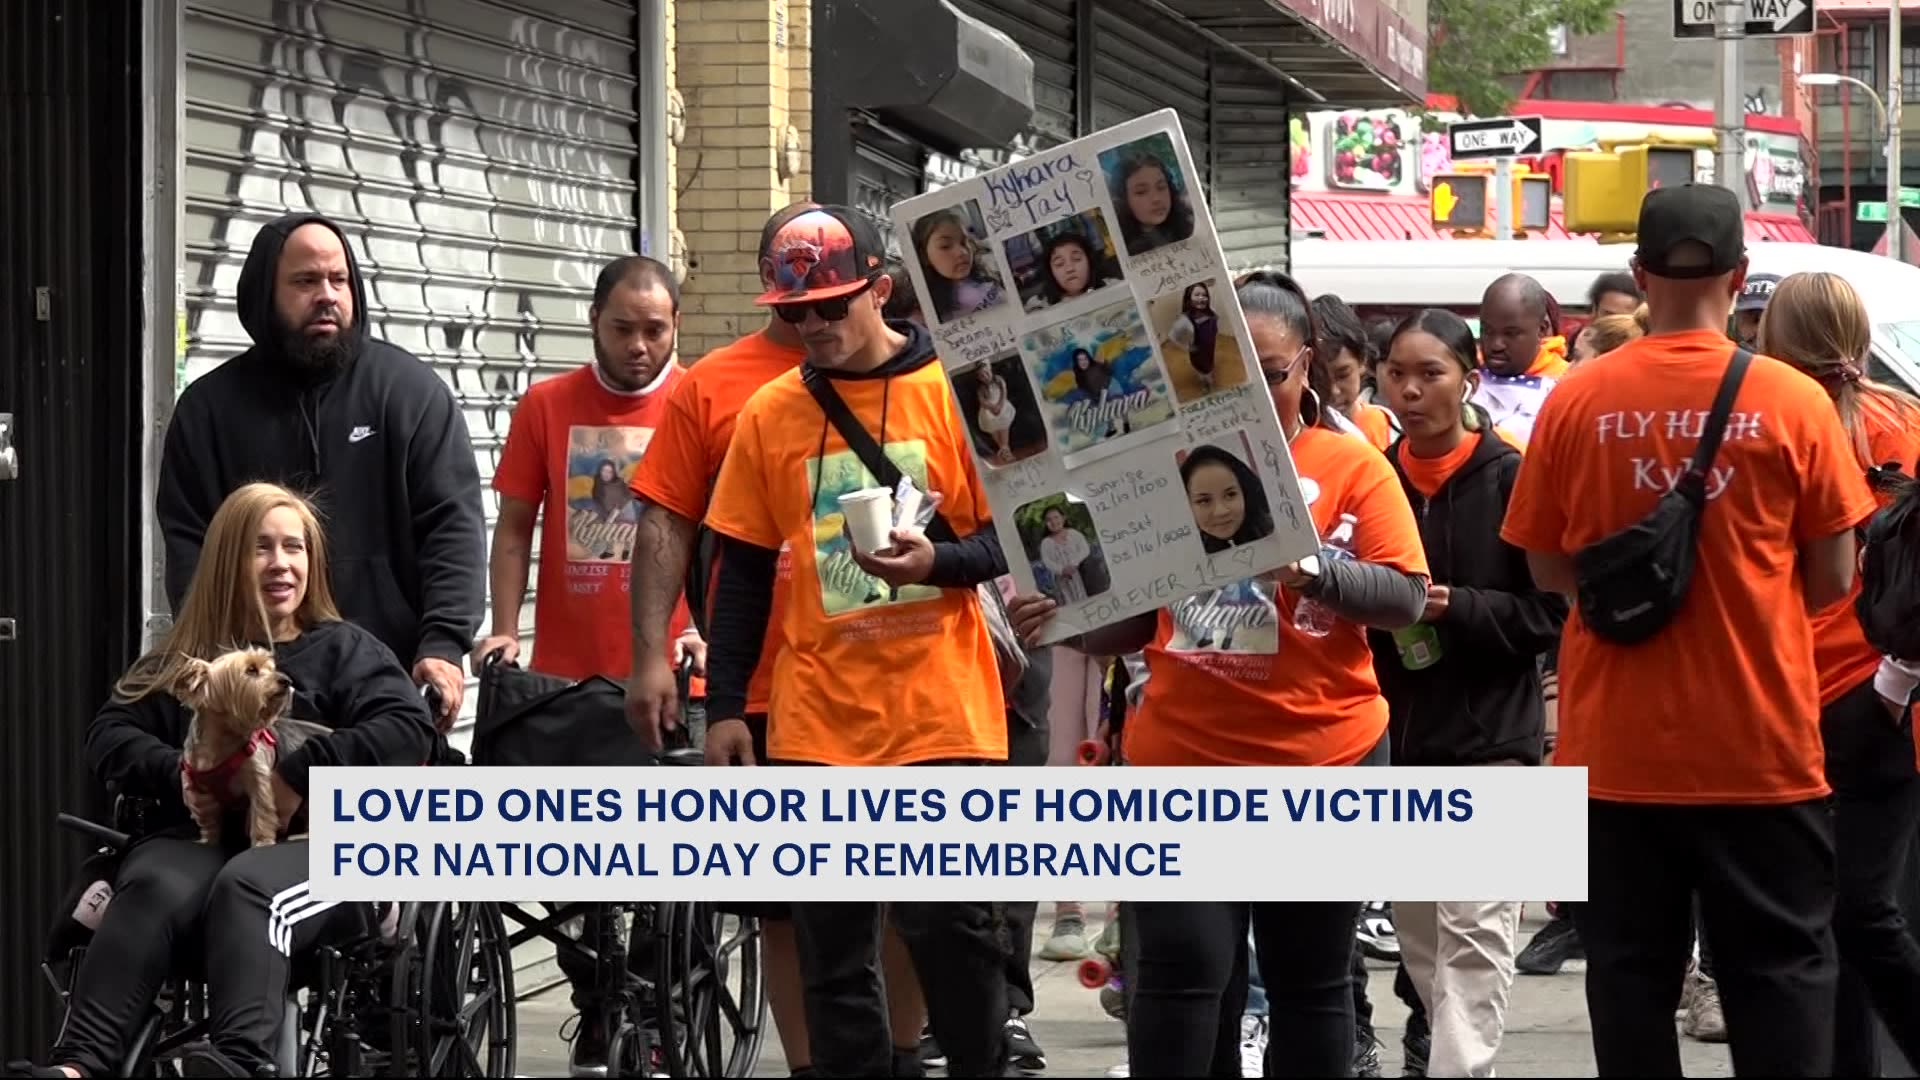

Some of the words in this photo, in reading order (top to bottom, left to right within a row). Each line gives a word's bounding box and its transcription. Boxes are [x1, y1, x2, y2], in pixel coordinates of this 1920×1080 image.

[1751, 0, 1792, 18] WAY
[1462, 133, 1488, 148] ONE
[1499, 130, 1529, 146] WAY
[1597, 411, 1656, 444] FLY
[1664, 408, 1763, 442] HIH
[1629, 457, 1736, 500] Kyy
[1080, 573, 1183, 627] FOREVER
